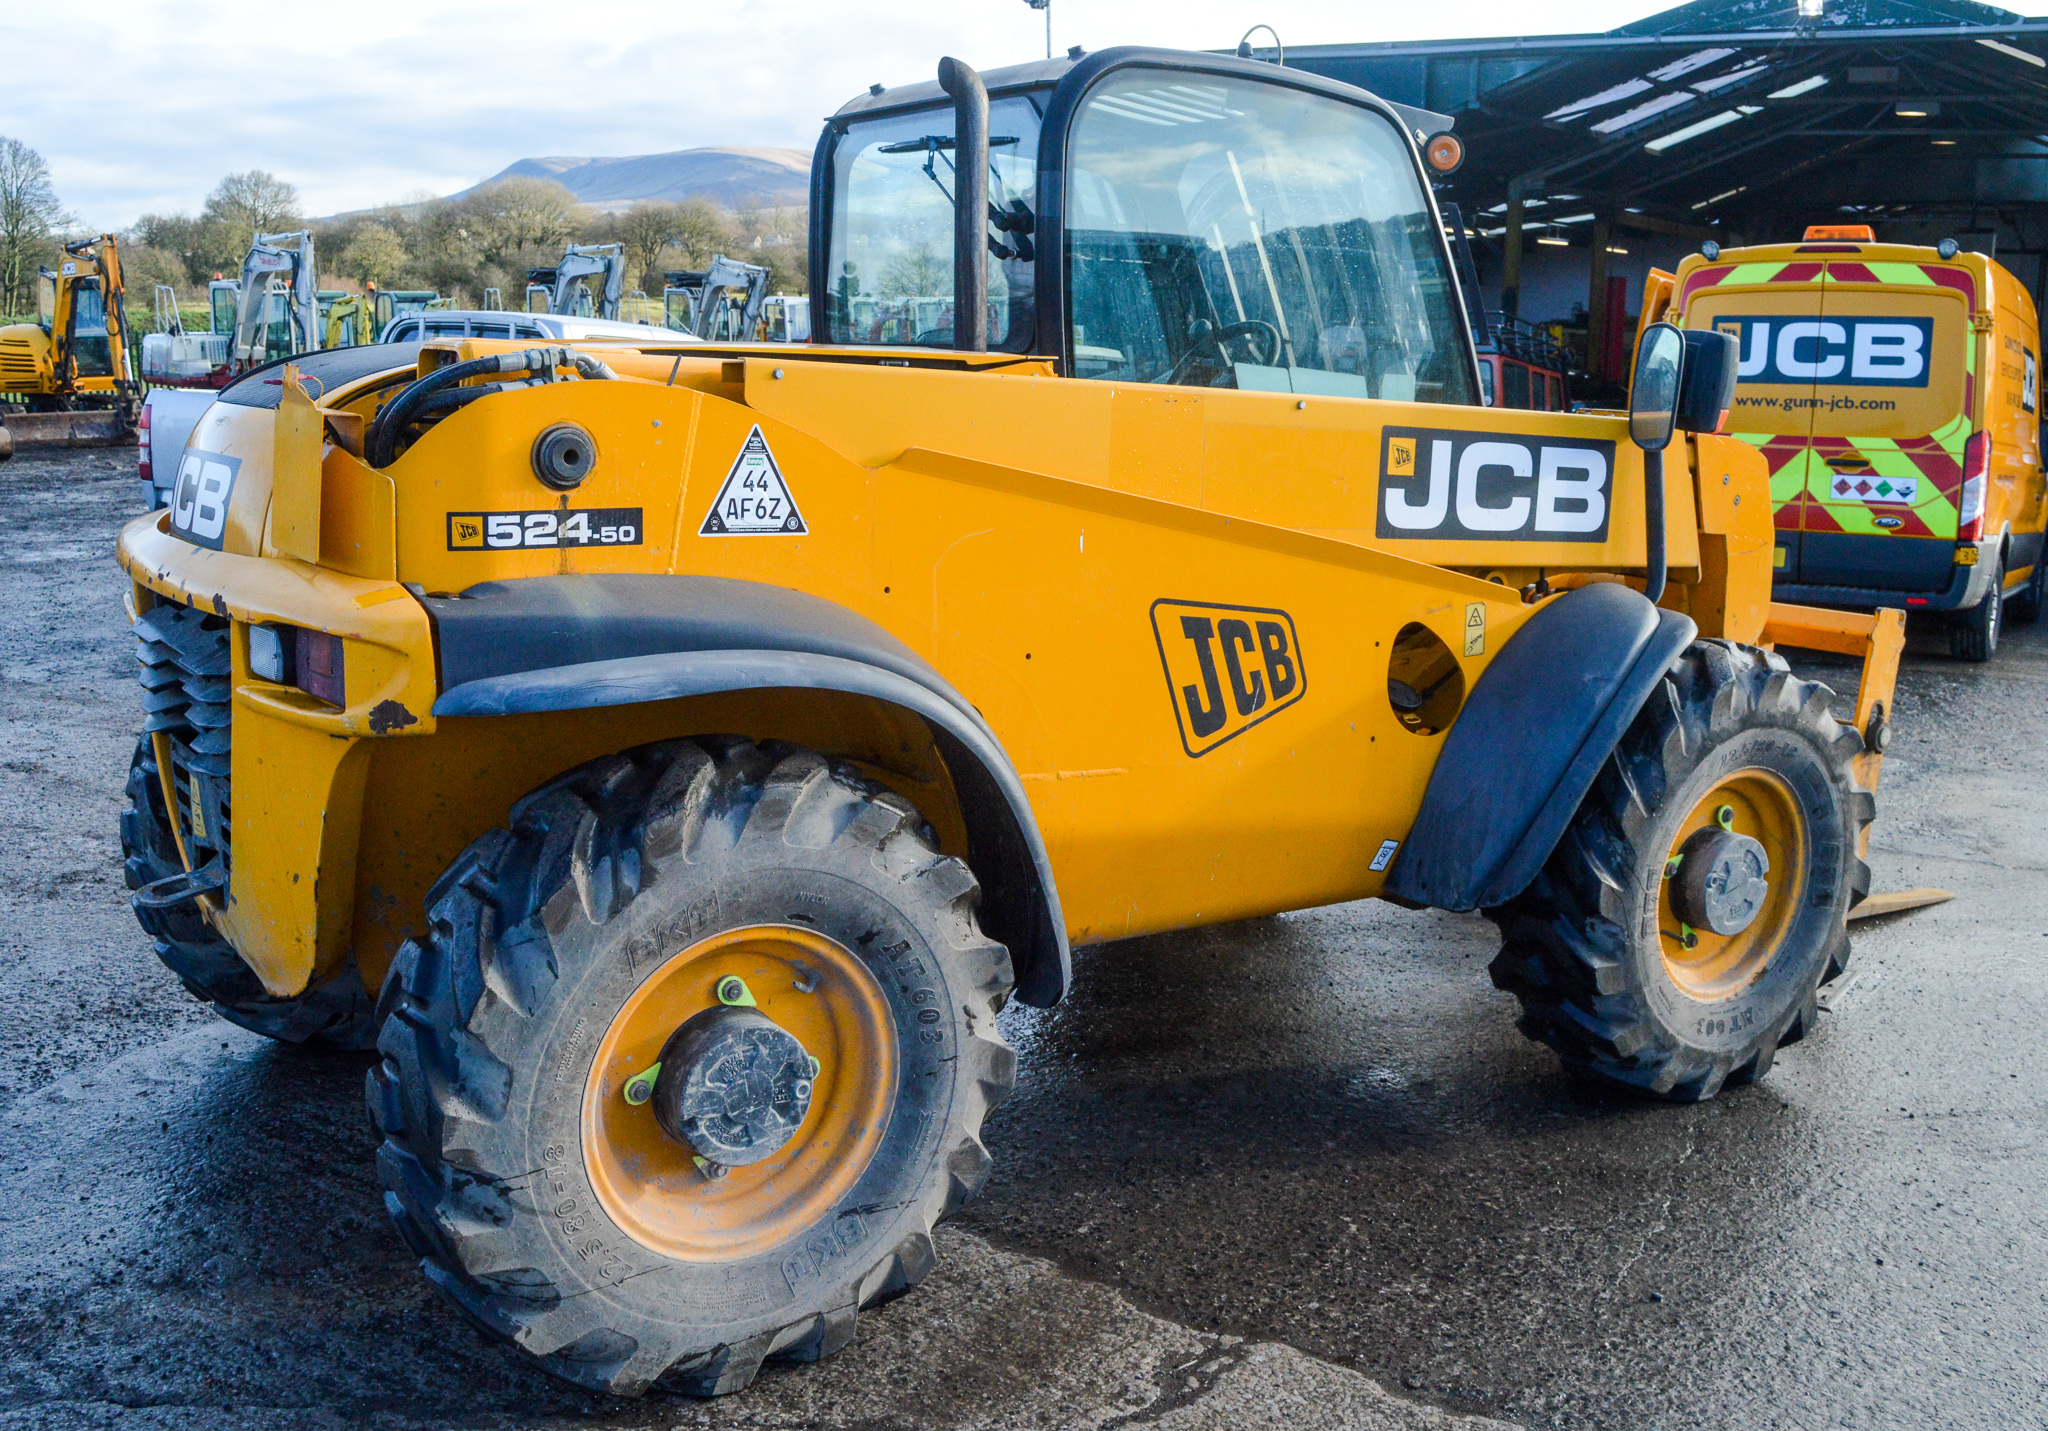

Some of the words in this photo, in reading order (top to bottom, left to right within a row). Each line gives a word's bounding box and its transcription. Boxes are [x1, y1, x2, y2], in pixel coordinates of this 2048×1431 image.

[62, 262, 75, 275] JCB
[1738, 322, 1924, 379] JCB
[1735, 395, 1896, 412] www.gunn-jcb.com
[1394, 447, 1411, 466] JCB
[743, 470, 768, 492] 44
[1385, 440, 1607, 532] JCB
[726, 497, 781, 520] AF6Z
[459, 524, 479, 539] JCB
[488, 512, 636, 547] 524-50
[1179, 615, 1297, 738] JCB
